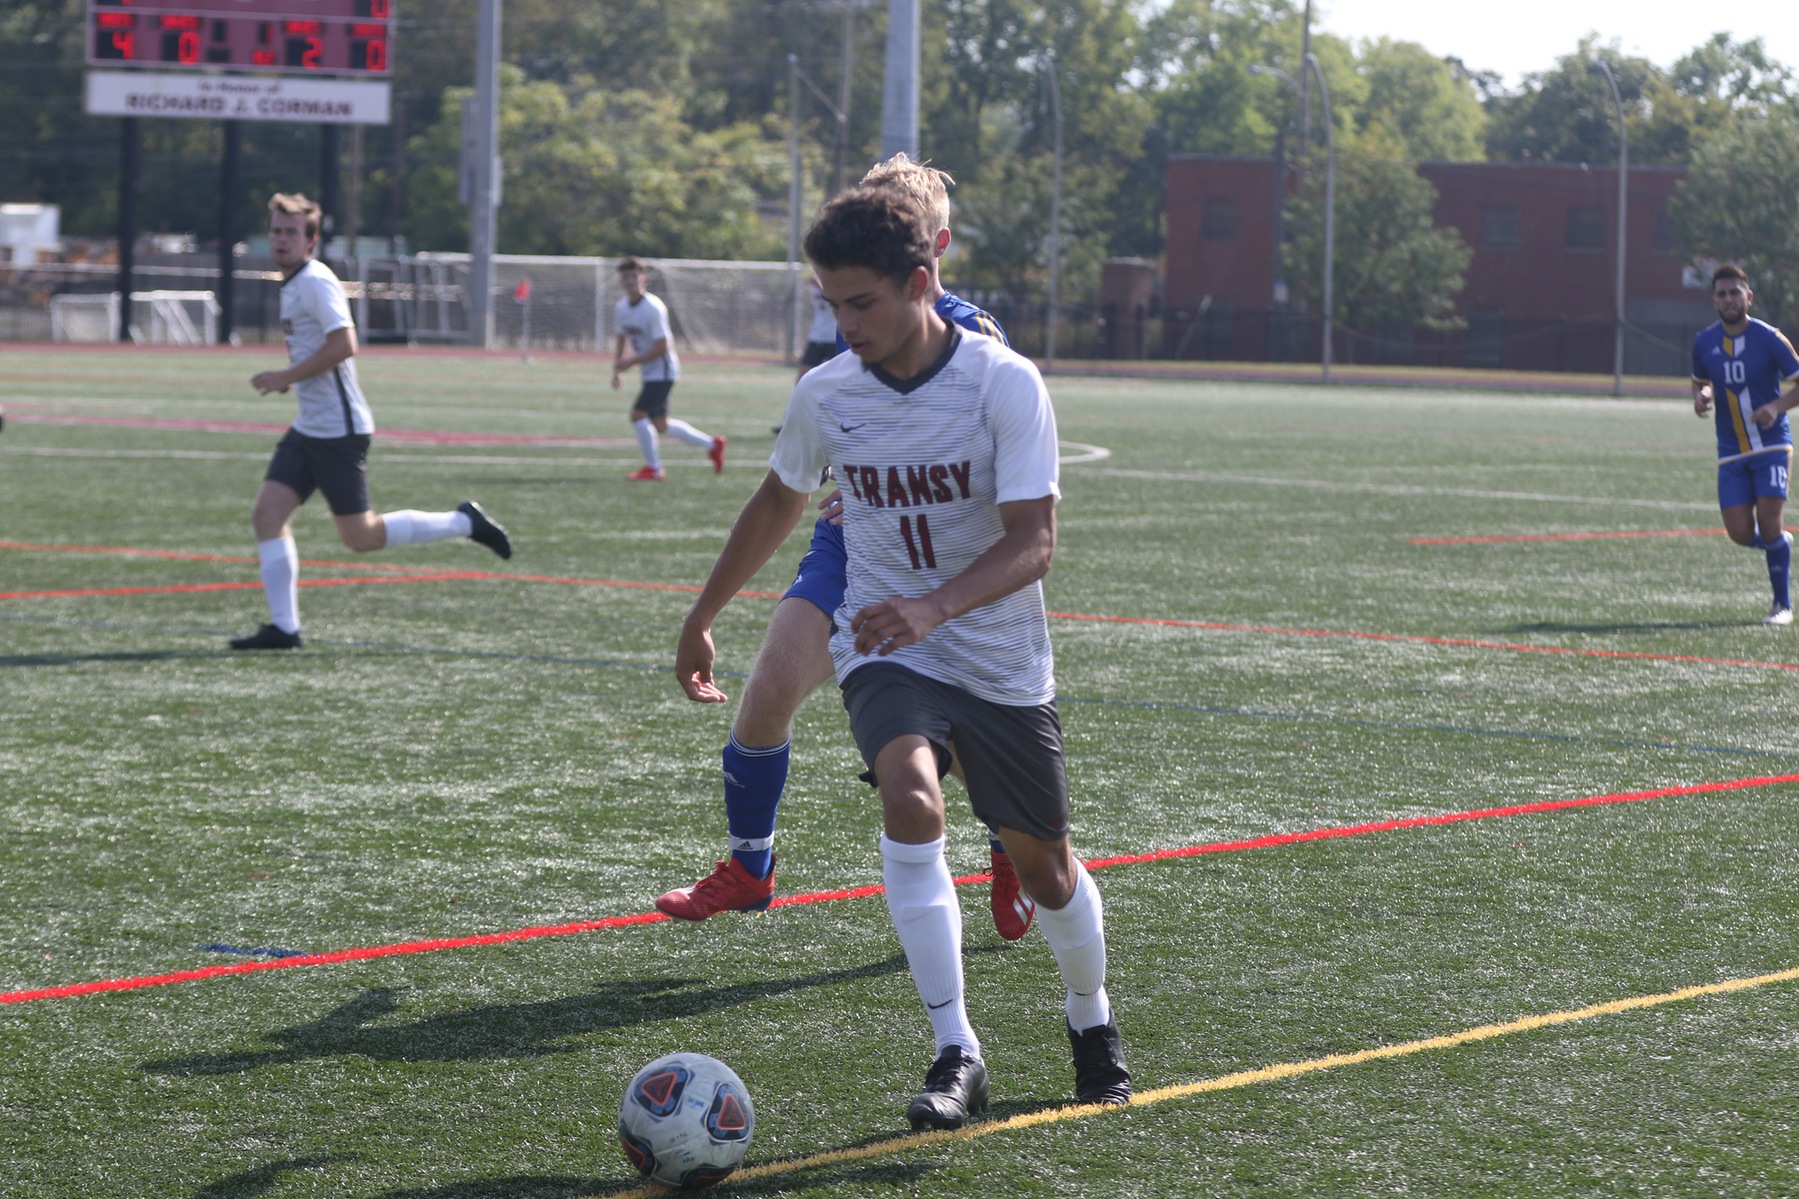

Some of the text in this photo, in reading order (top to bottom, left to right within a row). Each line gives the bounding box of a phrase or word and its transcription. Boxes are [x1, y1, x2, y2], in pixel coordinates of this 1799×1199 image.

[112, 31, 134, 60] 4
[178, 31, 200, 65] 0
[302, 37, 324, 70] 2
[366, 39, 387, 72] 0
[125, 93, 225, 112] RICHARD
[256, 98, 353, 116] CORMAN
[1723, 360, 1746, 384] 10
[843, 460, 971, 508] TRANSY
[900, 513, 937, 570] 11
